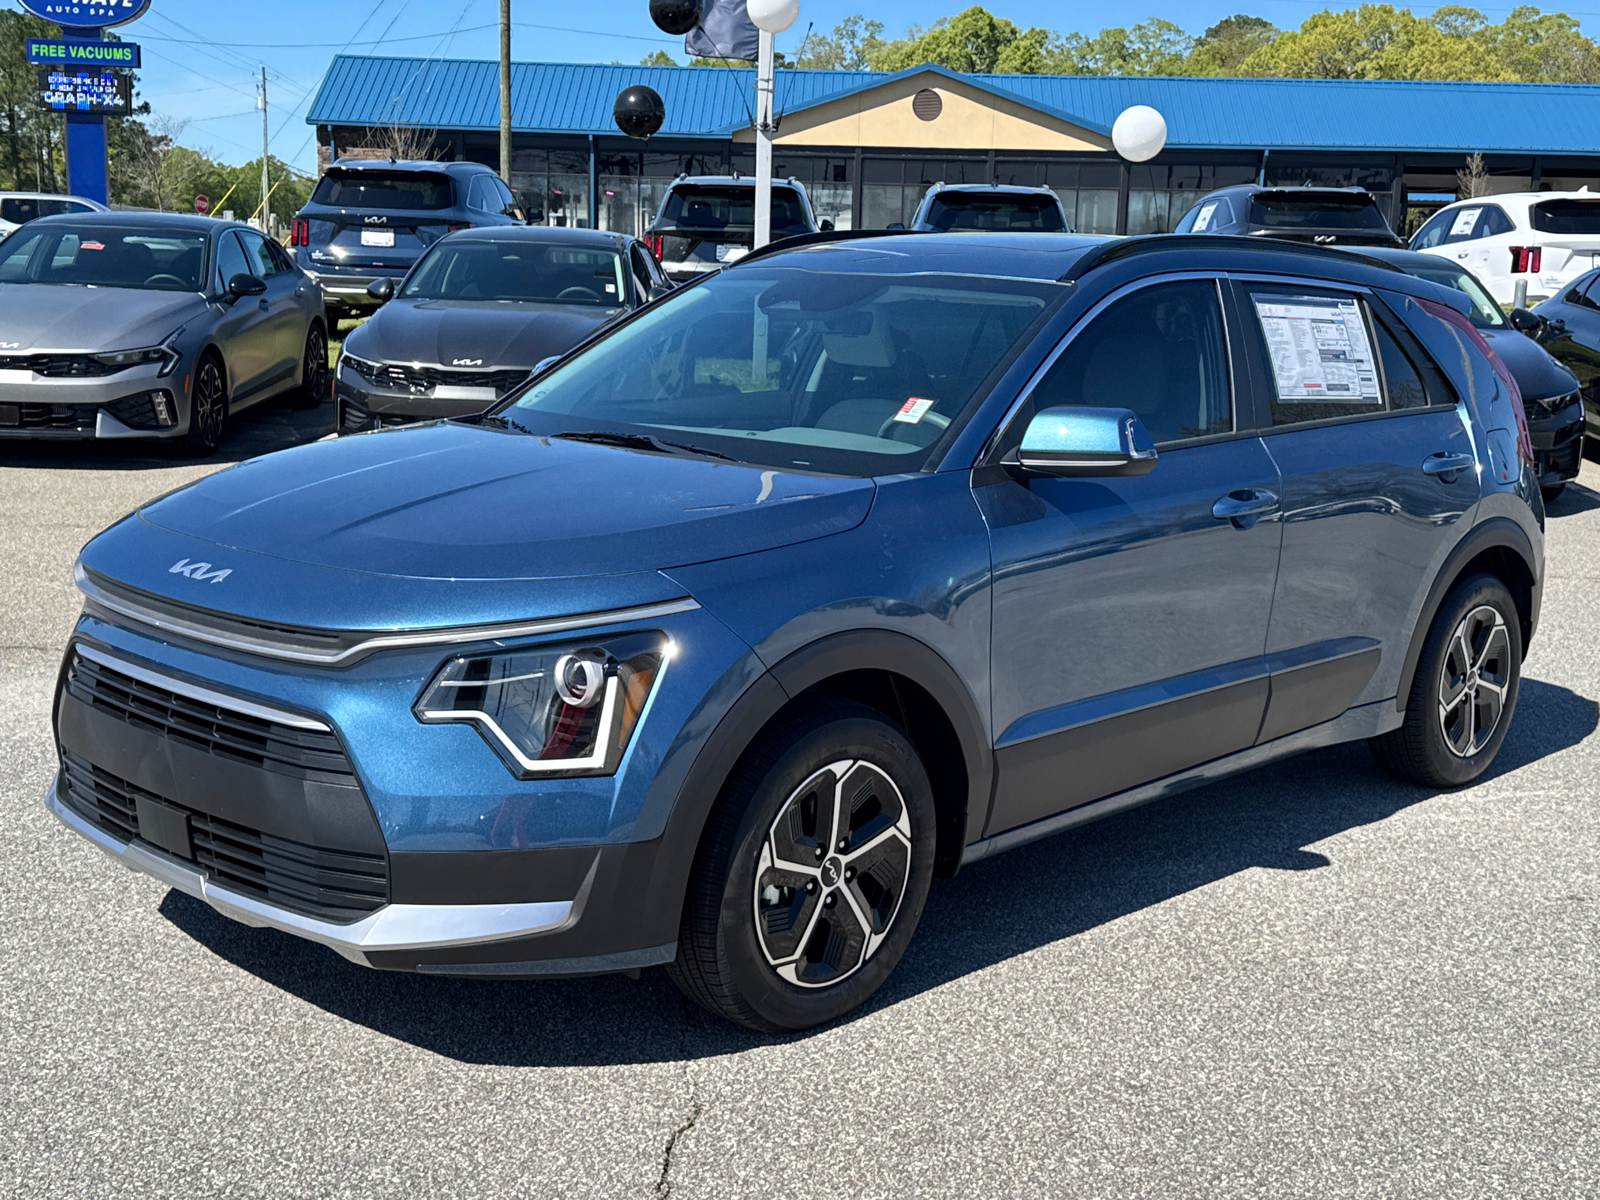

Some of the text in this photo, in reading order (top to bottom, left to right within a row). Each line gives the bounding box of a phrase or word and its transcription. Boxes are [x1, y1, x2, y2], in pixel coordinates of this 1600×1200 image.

[46, 5, 114, 16] AUTO SPA
[31, 44, 132, 60] FREE VACUUMS
[196, 199, 208, 209] STOP
[452, 358, 482, 366] KIA
[168, 558, 233, 584] KIA
